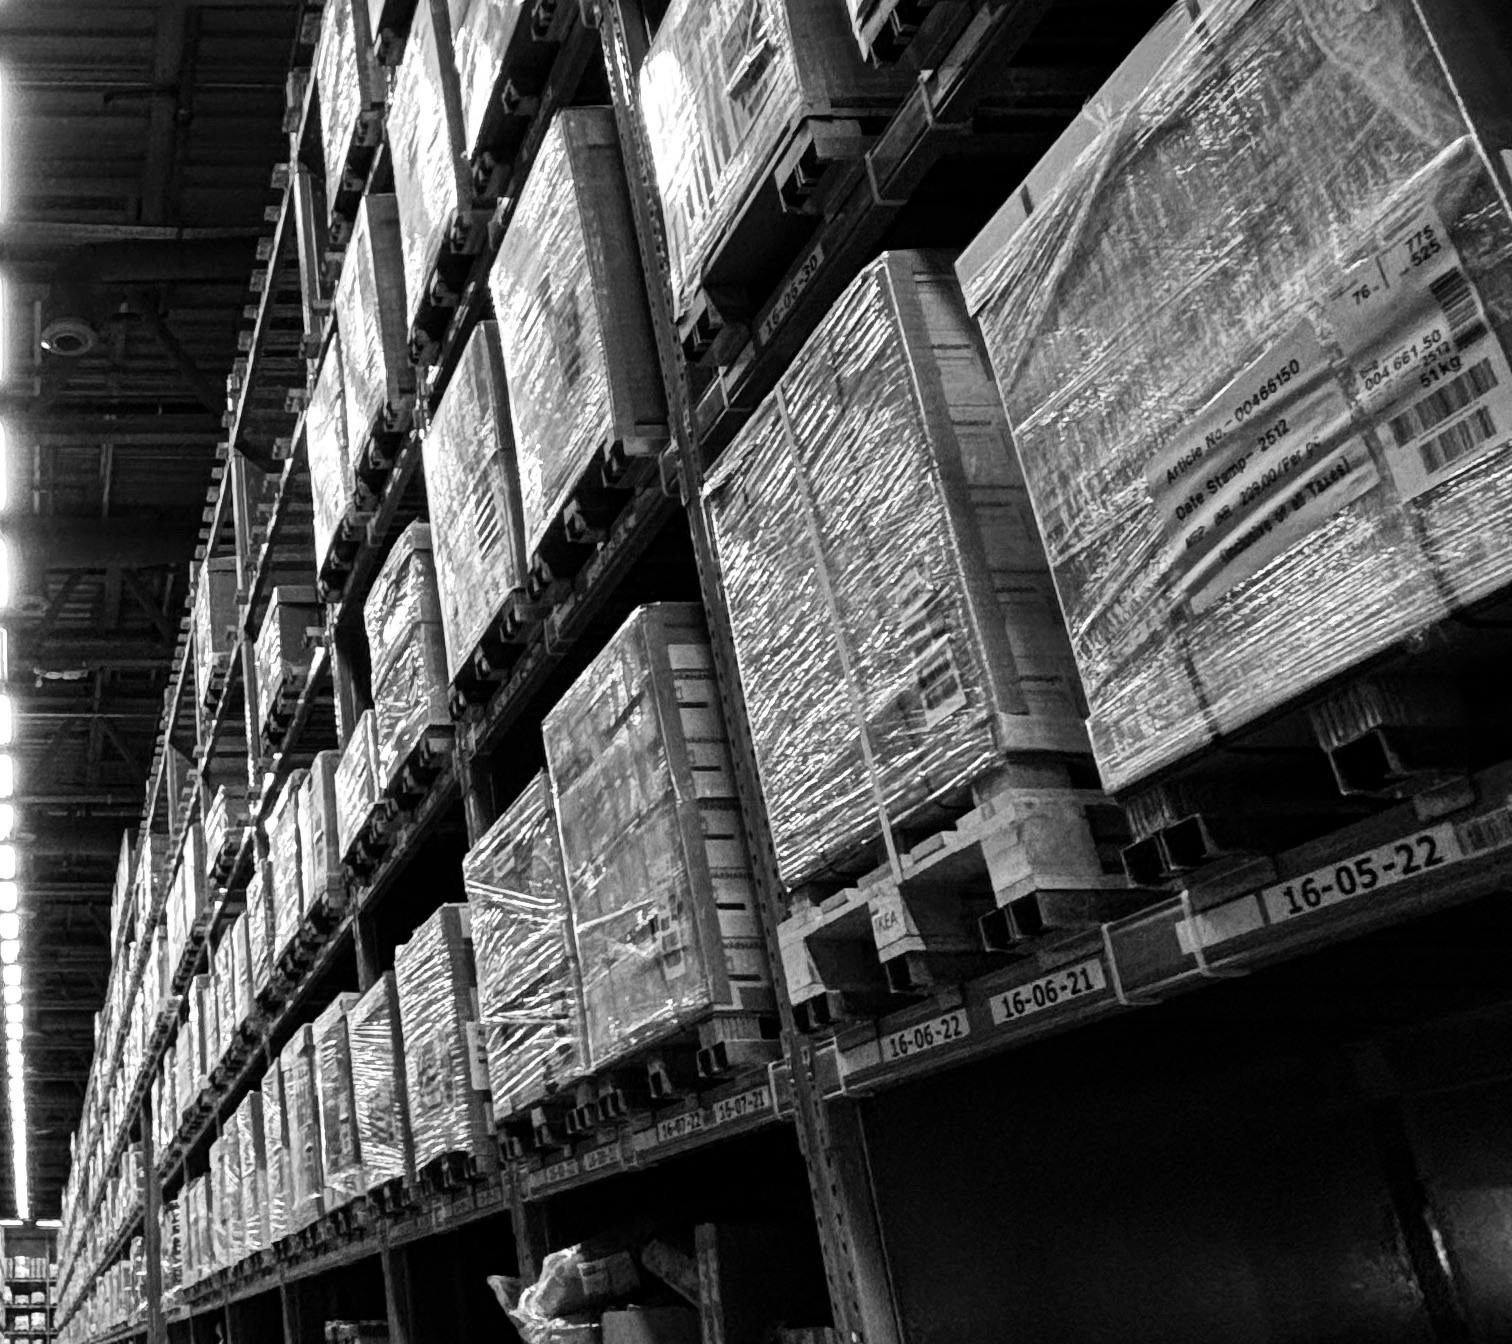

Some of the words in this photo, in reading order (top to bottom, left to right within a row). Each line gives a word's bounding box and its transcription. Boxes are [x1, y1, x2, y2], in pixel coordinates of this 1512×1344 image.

[1405, 224, 1435, 254] 775
[1411, 240, 1442, 267] 525
[1166, 446, 1203, 484] Article
[1174, 493, 1205, 522] Date
[1282, 834, 1445, 916] 16-05-22
[1000, 967, 1096, 1019] 16-06-21
[889, 1015, 964, 1058] 16-06-22
